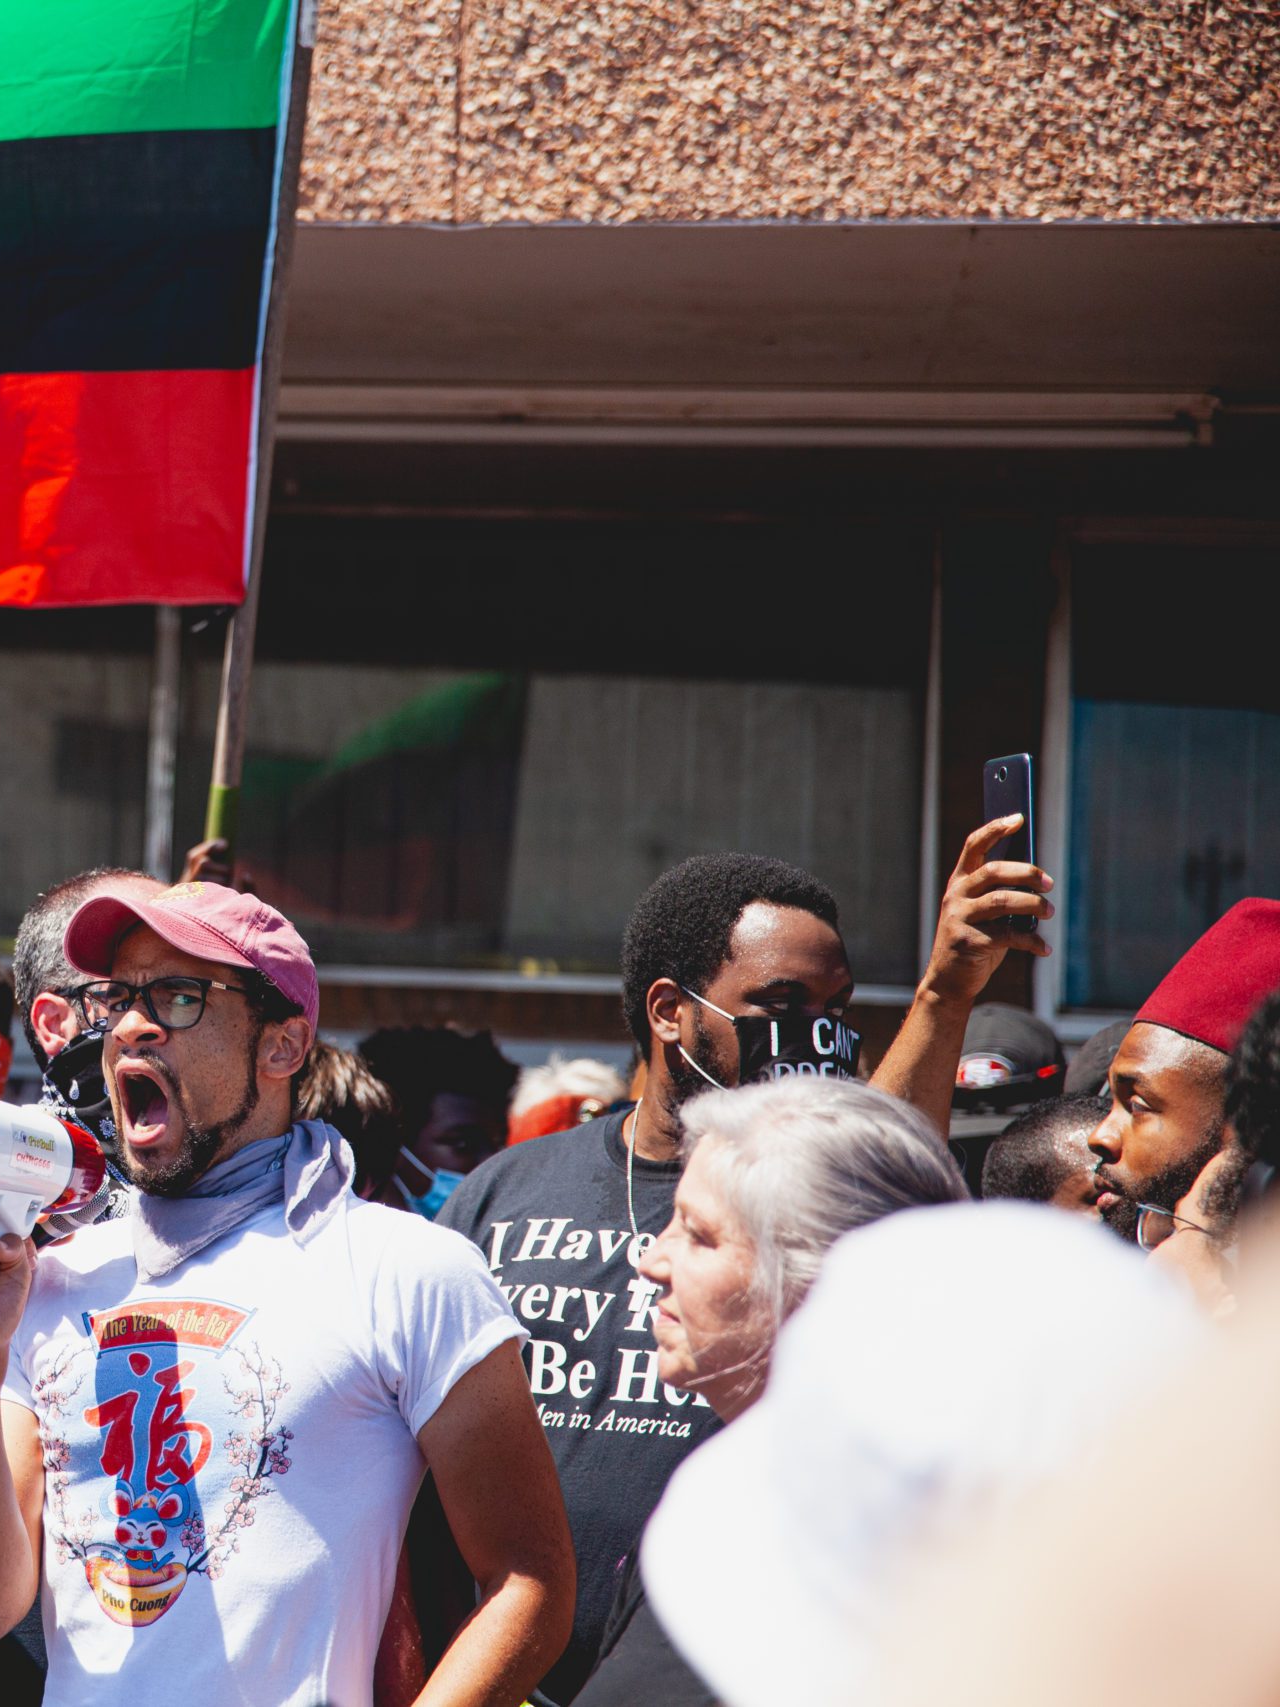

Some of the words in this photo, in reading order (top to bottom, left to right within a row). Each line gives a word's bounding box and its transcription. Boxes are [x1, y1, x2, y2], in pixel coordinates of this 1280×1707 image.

[489, 1221, 513, 1271] I
[511, 1218, 657, 1268] Have
[100, 1316, 127, 1340] The
[131, 1311, 163, 1333] Year
[165, 1309, 184, 1330] of
[182, 1309, 205, 1334] the
[204, 1312, 233, 1340] Rat
[499, 1281, 616, 1342] very
[529, 1339, 596, 1398] Be
[568, 1405, 591, 1430] in
[594, 1409, 692, 1438] America
